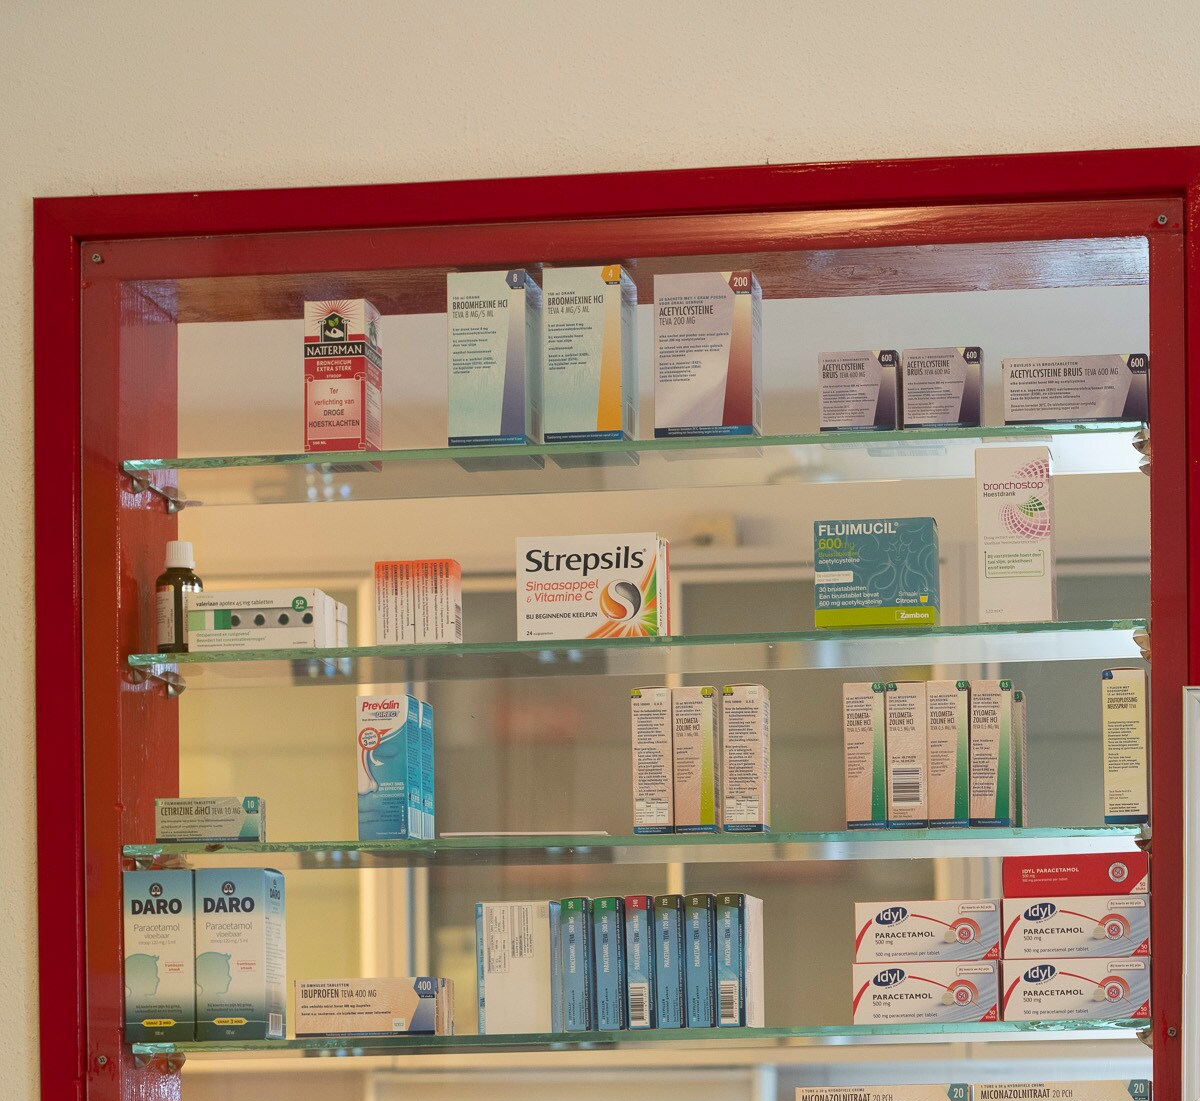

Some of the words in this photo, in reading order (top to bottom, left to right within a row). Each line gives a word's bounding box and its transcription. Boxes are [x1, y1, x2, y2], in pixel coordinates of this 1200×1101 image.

[513, 274, 517, 282] 8
[608, 269, 613, 278] 4
[734, 277, 747, 287] 200
[453, 300, 497, 310] BROOMHEXINE
[548, 296, 592, 306] BROOMHEXINE
[659, 305, 713, 316] ACETYLCYSTEINE
[307, 345, 362, 355] NATTERMAN
[966, 351, 977, 359] 600
[881, 354, 892, 362] 600
[1131, 358, 1144, 367] 600
[822, 363, 865, 371] ACETYLCYSTEINE
[907, 360, 950, 368] ACETYLCYSTEINE
[822, 371, 838, 379] BRUIS
[1010, 368, 1062, 379] ACETYLCYSTEINE
[1063, 368, 1083, 377] BRUIS
[309, 420, 360, 428] HOESTKLACHTEN
[983, 482, 1043, 490] bronchostop
[526, 546, 643, 576] Strepsils
[526, 579, 599, 591] Sinaasappel
[534, 592, 583, 602] Vitamine
[585, 591, 594, 600] C
[362, 699, 399, 712] Prevalin
[131, 898, 183, 915] DARO
[203, 897, 255, 913] DARO
[880, 908, 904, 924] Idyl
[1028, 904, 1052, 920] Idyl
[134, 923, 180, 932] Paracetamol
[206, 921, 253, 930] Paracetamol
[878, 970, 901, 986] Idyl
[1028, 966, 1051, 982] Idyl
[418, 981, 431, 991] 400
[301, 989, 339, 999] IBUPROFEN
[954, 1088, 963, 1098] 20
[1134, 1083, 1144, 1093] 20
[981, 1089, 1050, 1100] MICONAZOLNITRAAT
